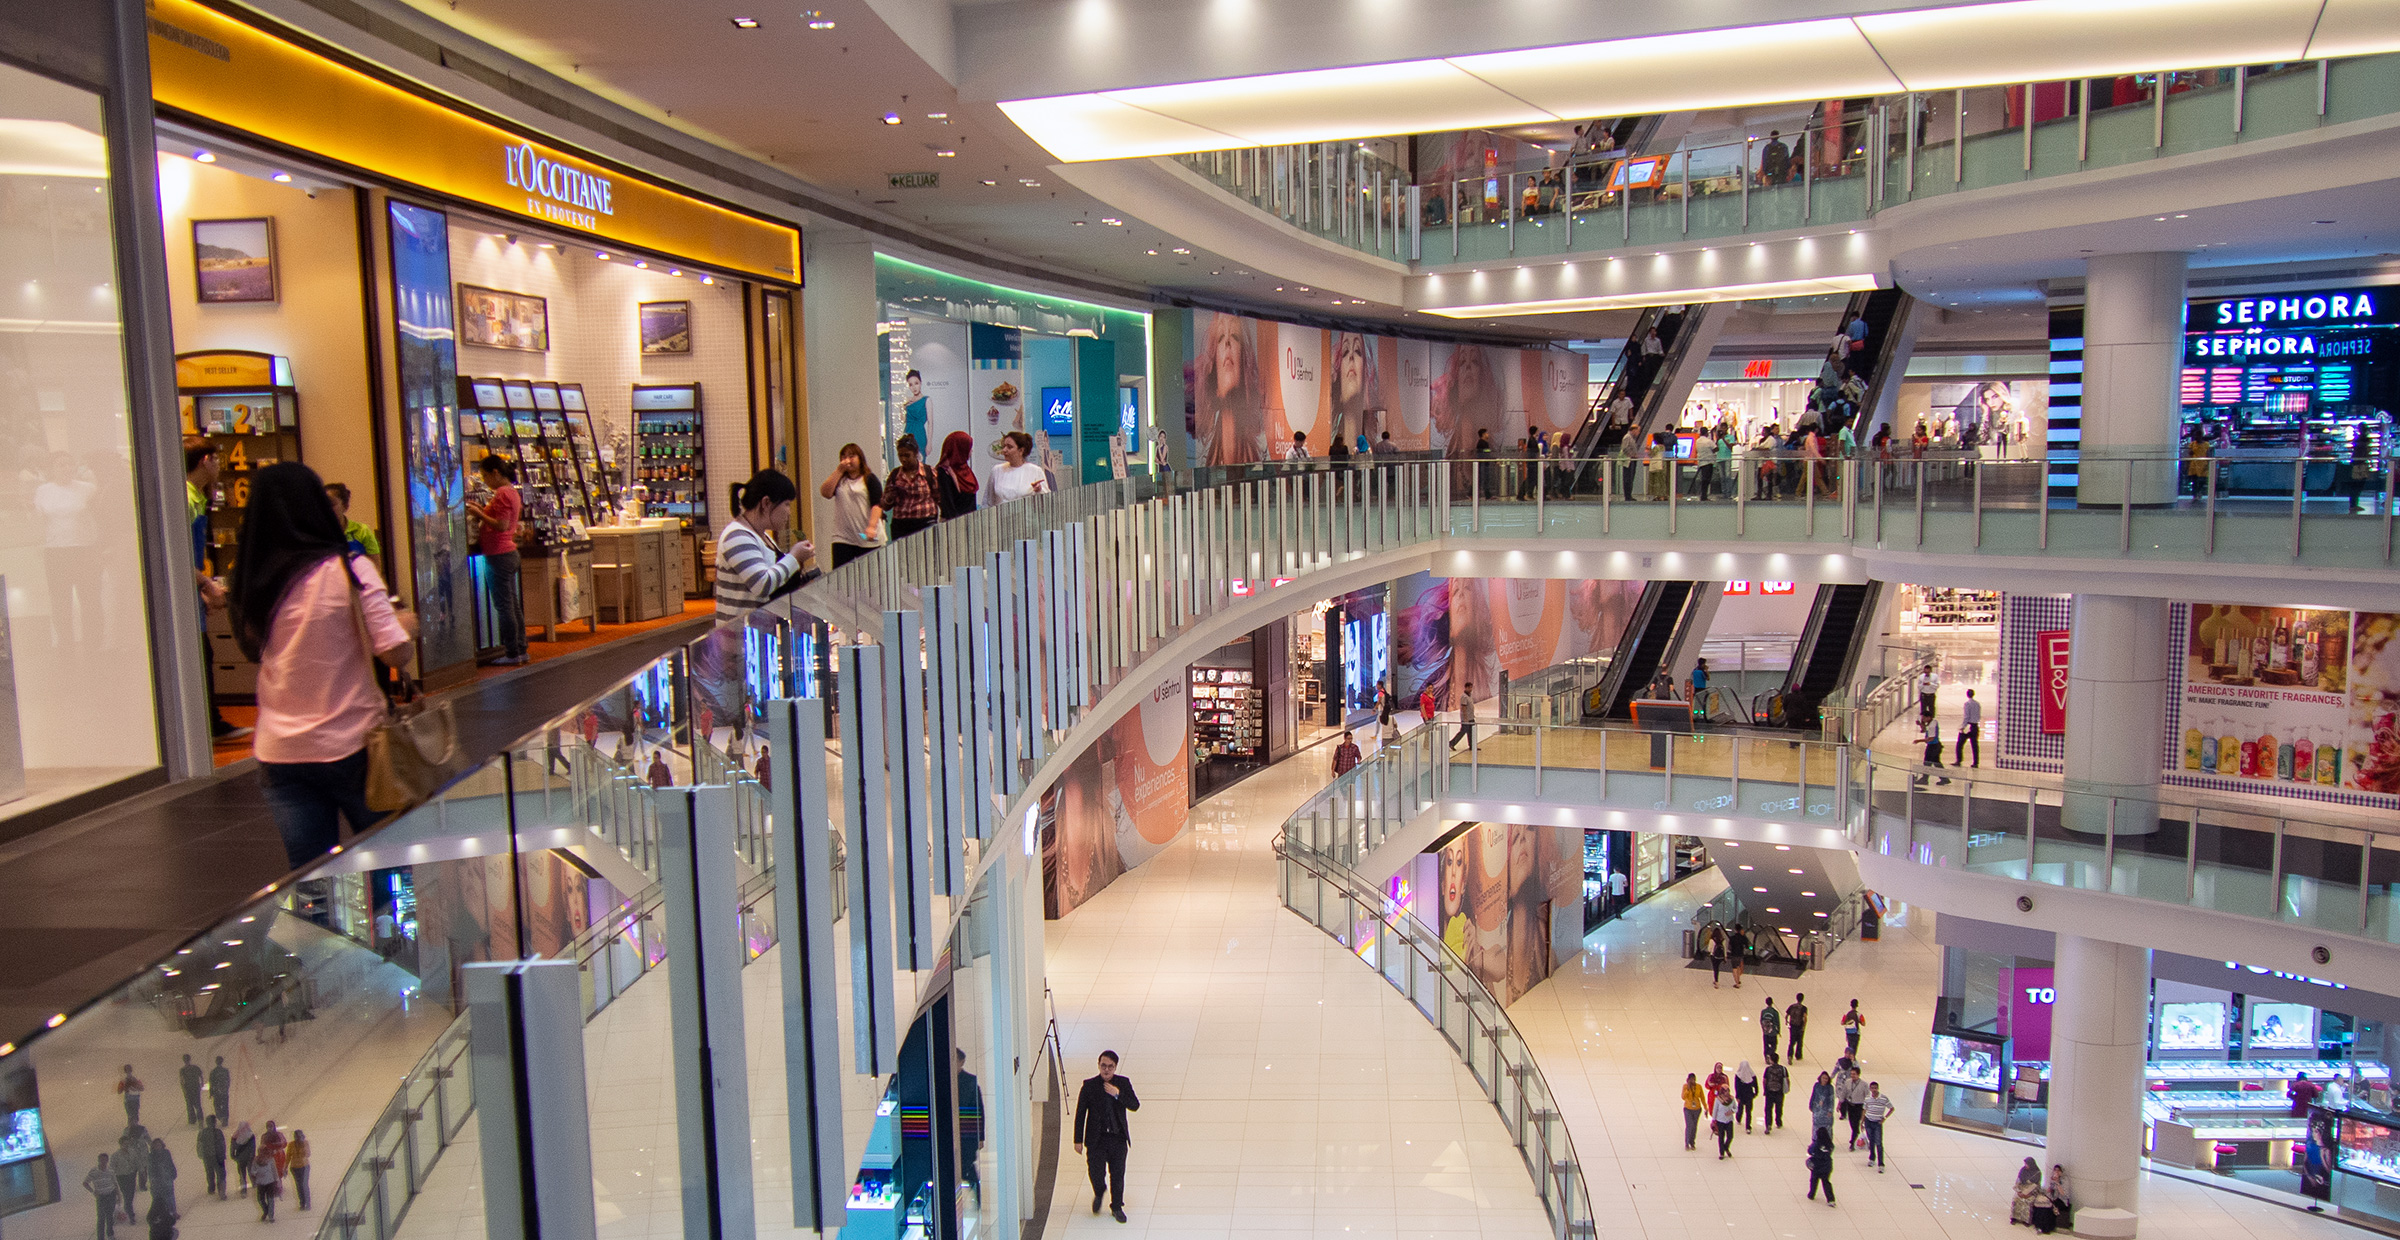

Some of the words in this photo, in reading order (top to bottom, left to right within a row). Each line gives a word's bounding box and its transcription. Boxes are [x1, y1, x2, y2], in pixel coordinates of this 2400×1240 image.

[504, 143, 613, 215] L'OCCITANE
[899, 174, 938, 188] KELUAR
[527, 198, 541, 214] EN
[545, 203, 596, 230] PROVENCE
[2217, 294, 2374, 324] SEPHORA
[2196, 336, 2315, 356] SEPHORA
[204, 367, 217, 375] BEST
[218, 366, 237, 375] SELLER
[1296, 367, 1313, 381] sentral
[1744, 360, 1772, 378] H&M
[2283, 375, 2308, 383] STUDIO
[182, 404, 198, 434] 1
[233, 404, 250, 434] 2
[1275, 422, 1284, 439] Nu
[230, 440, 247, 471] 4
[233, 477, 249, 507] 6
[1499, 628, 1507, 643] Nu
[1500, 637, 1533, 659] experiences
[2187, 685, 2235, 697] AMERICA'S
[2238, 688, 2279, 701] FAVORITE
[2198, 697, 2216, 705] MAKE
[2218, 698, 2253, 707] FRAGRANCE
[1134, 764, 1145, 786] Nu
[1134, 767, 1175, 804] experiences
